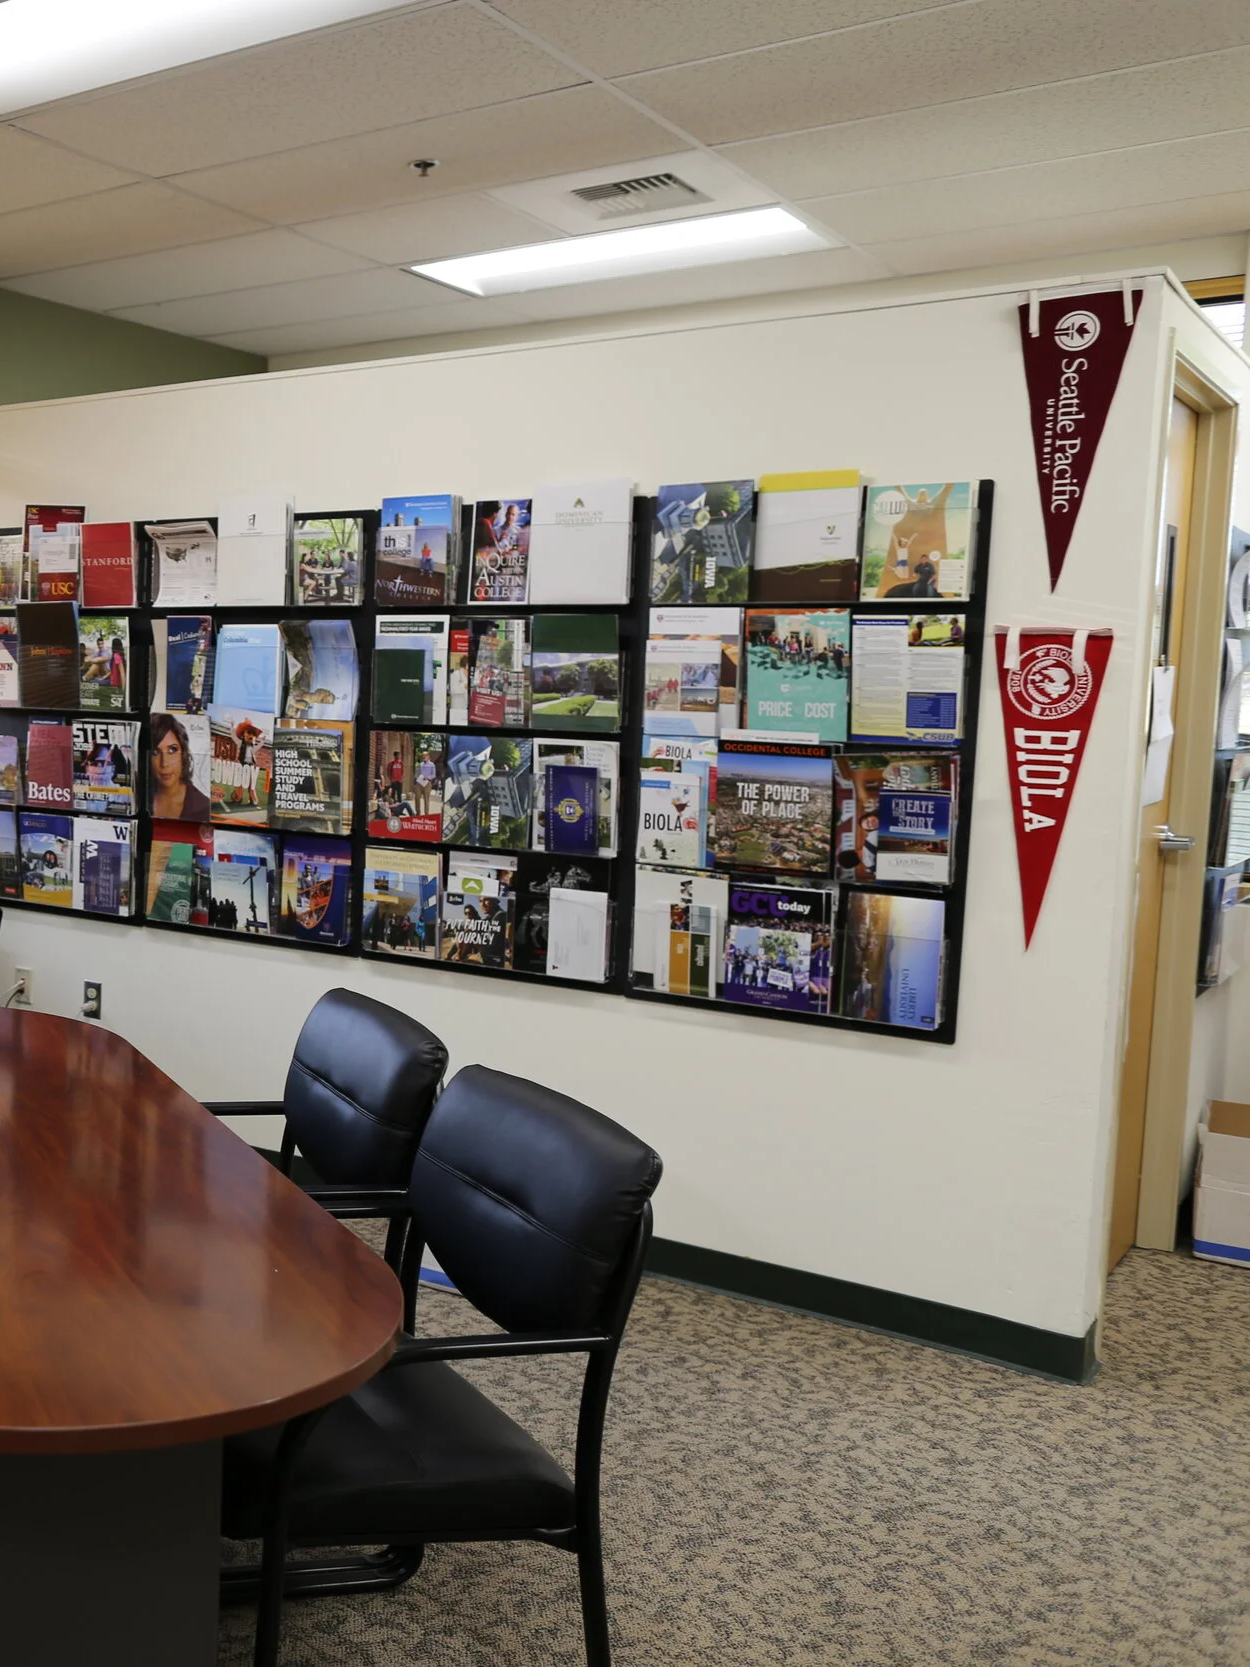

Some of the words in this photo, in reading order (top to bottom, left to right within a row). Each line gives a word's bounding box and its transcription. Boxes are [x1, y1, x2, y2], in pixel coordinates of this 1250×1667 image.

[1056, 357, 1087, 434] Seattle
[1041, 398, 1055, 475] UNIVERSITY
[1050, 437, 1081, 514] Pacific
[382, 548, 412, 557] college
[82, 557, 133, 567] STANFORD
[704, 556, 717, 588] IOWA
[51, 581, 75, 595] USC
[376, 575, 441, 598] NORTHWESTERN
[474, 586, 523, 598] COLLEGE
[1049, 648, 1073, 662] BIOL
[1043, 672, 1089, 717] NIVERSITY
[758, 701, 793, 717] PRICE
[804, 702, 837, 719] COST
[275, 749, 298, 759] HIGH
[665, 745, 692, 760] BIOLA
[723, 743, 781, 755] OCCIDENTAL
[783, 745, 826, 757] COLLEGE
[275, 759, 312, 768] SCHOOL
[275, 767, 313, 777] SUMMER
[275, 776, 305, 785] STUDY
[1013, 727, 1082, 833] BIOLA
[28, 781, 71, 802] Bates
[275, 784, 296, 793] AND
[737, 782, 761, 799] THE
[764, 783, 810, 803] POWER
[275, 792, 310, 802] TRAVEL
[275, 801, 325, 812] PROGRAMS
[741, 800, 758, 816] OF
[762, 801, 803, 820] PLACE
[892, 798, 935, 814] CREATE
[490, 805, 500, 834] IOWA
[643, 812, 683, 833] BIOLA
[898, 816, 935, 831] STORY
[112, 825, 128, 840] W
[731, 890, 791, 918] GCU
[777, 900, 811, 914] today
[445, 918, 464, 931] PUT
[464, 918, 488, 932] FAITH
[451, 930, 495, 946] JOURNEY
